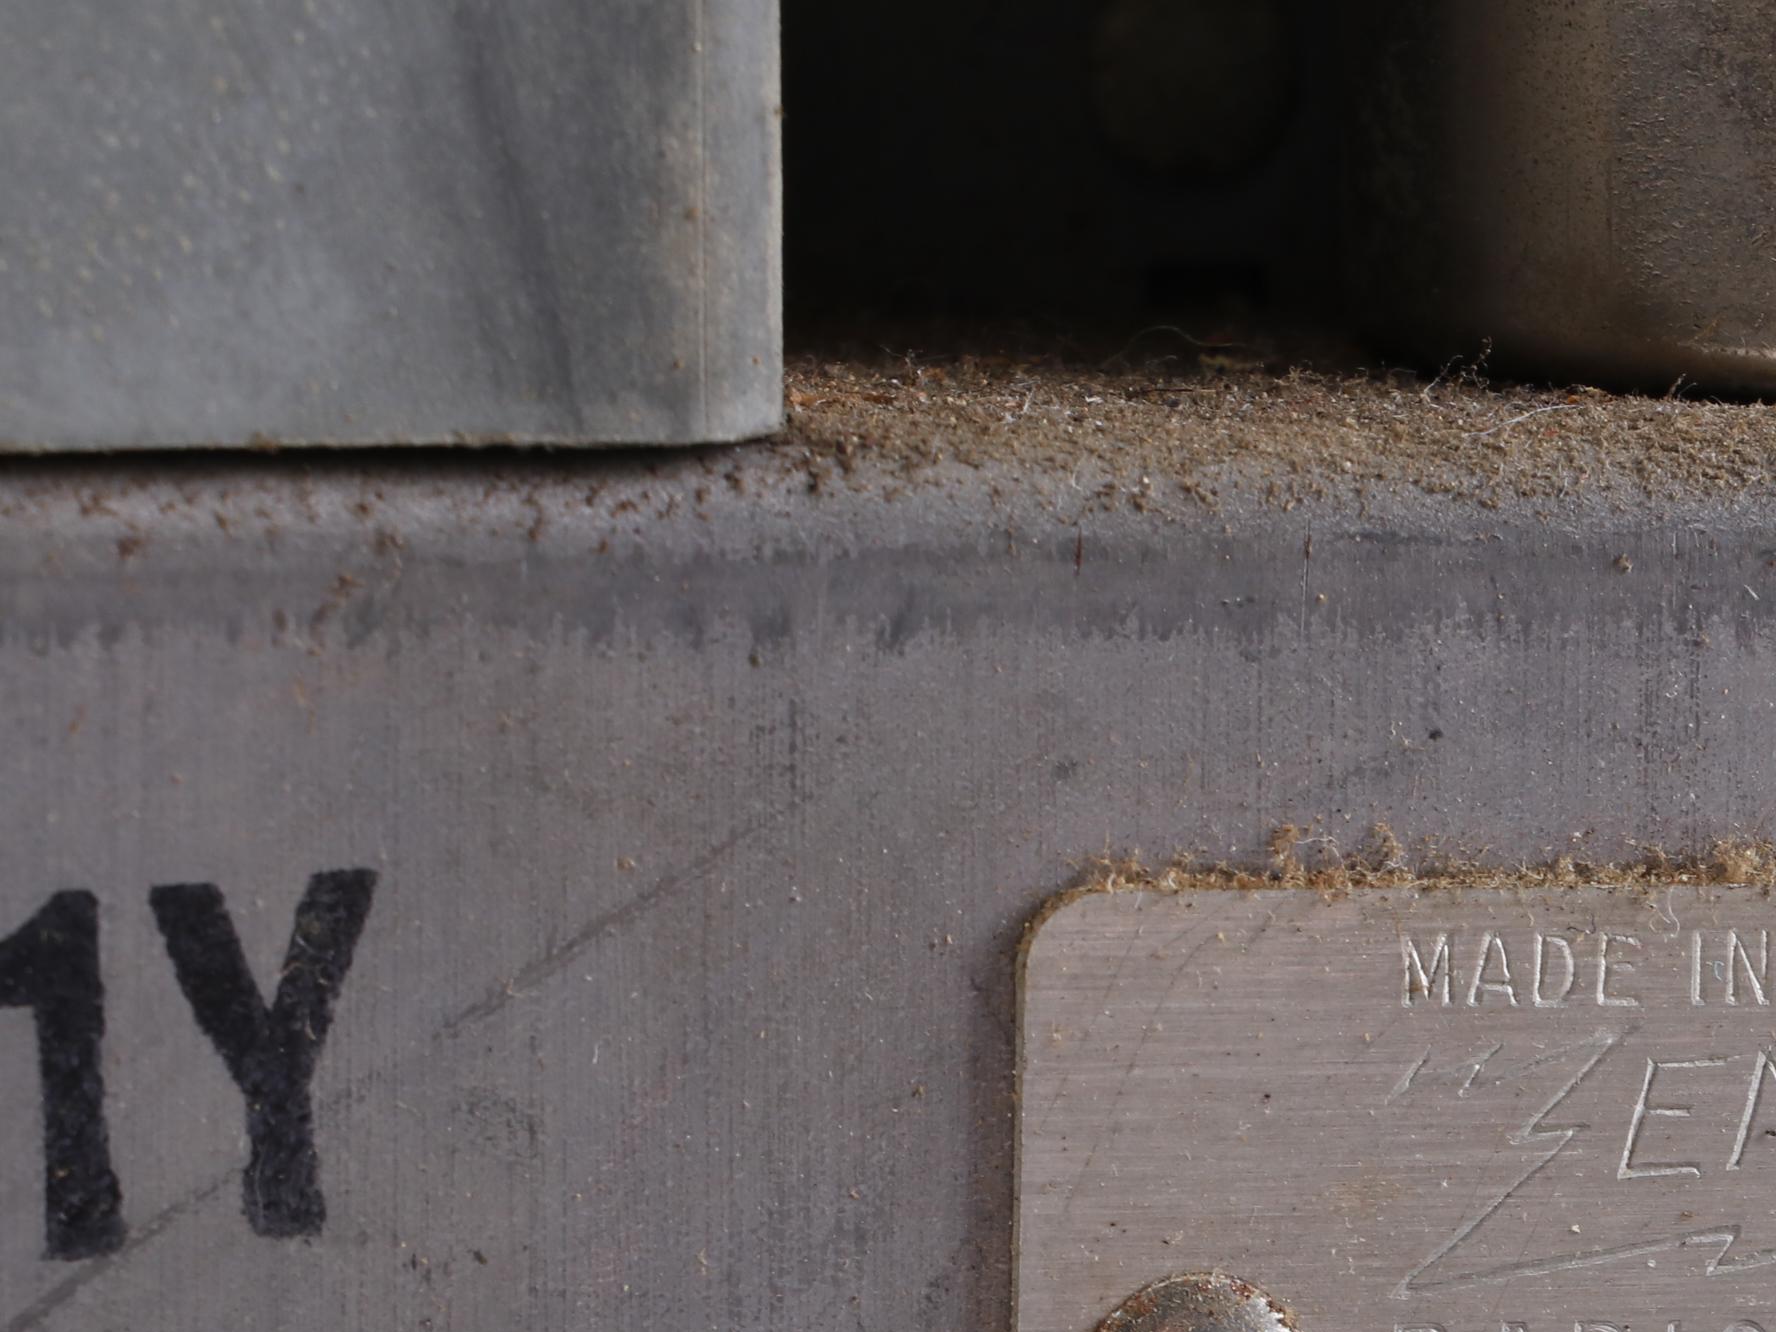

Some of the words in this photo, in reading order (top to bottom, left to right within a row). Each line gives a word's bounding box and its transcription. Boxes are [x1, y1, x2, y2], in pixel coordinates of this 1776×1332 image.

[0, 867, 380, 1261] 1Y
[1400, 930, 1645, 1008] MADE
[1691, 928, 1771, 1006] IN
